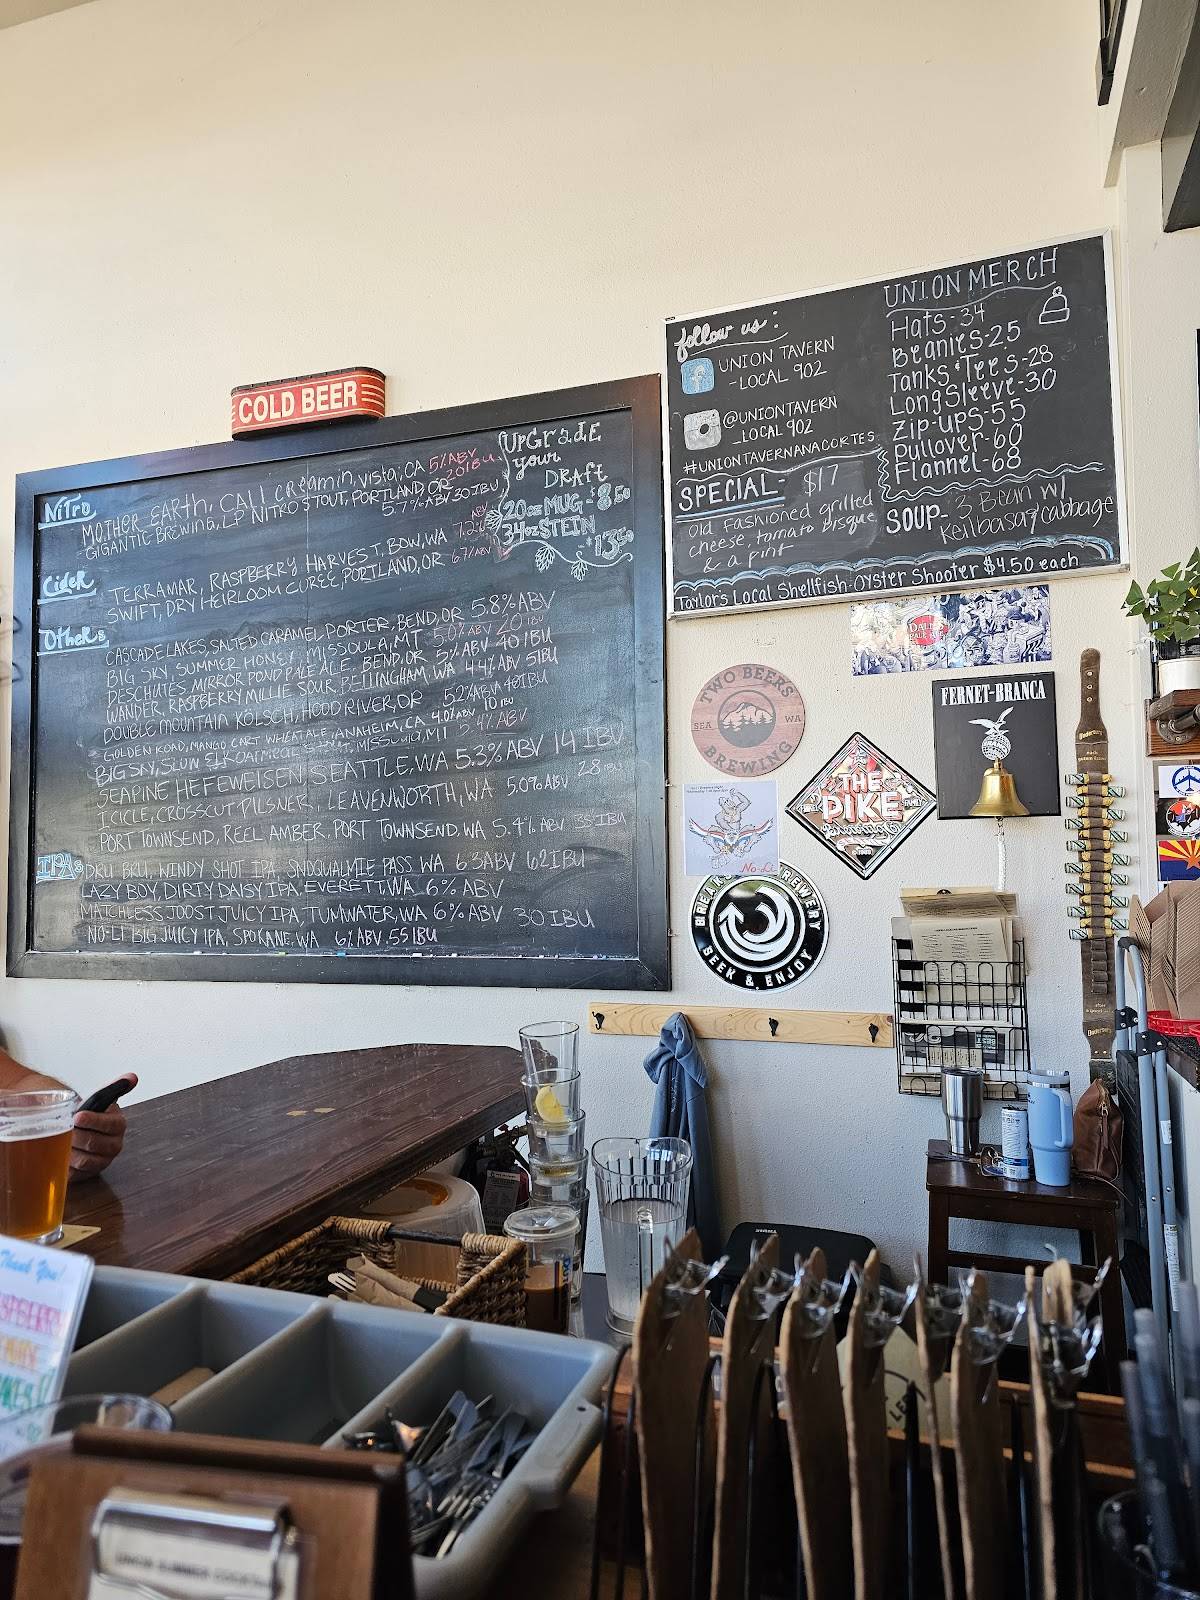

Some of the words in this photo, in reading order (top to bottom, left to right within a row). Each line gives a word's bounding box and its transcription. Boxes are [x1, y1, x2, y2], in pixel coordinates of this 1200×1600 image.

[883, 269, 962, 308] UNION
[968, 247, 1059, 291] MERCH
[674, 322, 734, 362] follow
[719, 349, 773, 373] UNION
[779, 336, 835, 360] TAVERN
[794, 360, 827, 380] 902
[888, 365, 950, 393] Tanks
[238, 391, 295, 424] COLD
[301, 380, 357, 414] BEER
[723, 395, 838, 429] @UNIONTAVERN
[786, 418, 814, 437] 902
[683, 431, 876, 475] #UNIONTAVERNANACORTES
[804, 464, 840, 497] $17
[543, 493, 583, 516] MUG
[819, 489, 874, 519] grilled
[978, 485, 1032, 513] Bean
[85, 531, 150, 560] GIGANTIC
[428, 477, 454, 496] OR
[539, 514, 596, 539] STEIN
[166, 599, 195, 618] DRY
[421, 551, 446, 569] OR
[733, 584, 773, 606] Local
[911, 562, 979, 585] Shooter
[984, 555, 1034, 576] $4.50
[1039, 552, 1080, 571] each
[105, 643, 166, 666] CASCADE
[209, 634, 257, 655] SALTED
[261, 626, 324, 646] CARAMEL
[441, 606, 465, 622] OR
[518, 590, 556, 613] ABV
[107, 668, 135, 688] BIG
[176, 656, 240, 677] SUMMER
[108, 680, 186, 708] DESCHUTES
[191, 671, 245, 693] MIRROR
[248, 668, 283, 685] POND
[286, 663, 318, 682] PALE
[405, 649, 428, 665] OR
[462, 637, 489, 657] ABV
[524, 627, 553, 648] IBU
[169, 688, 242, 713] RASPBERRY
[699, 670, 737, 705] TWO
[742, 664, 795, 699] BEERS
[940, 679, 1047, 706] FERNET-BRANCA
[103, 719, 157, 745] DOUBLE
[302, 701, 342, 721] HOOD
[396, 690, 423, 709] OR
[405, 715, 426, 730] CA
[785, 714, 802, 724] WA
[97, 781, 170, 808] SEAPINE
[415, 751, 450, 772] WA
[507, 734, 544, 760] ABV
[554, 729, 577, 755] 14
[704, 739, 794, 774] BREWING
[157, 802, 235, 823] CROSSCUT
[465, 777, 494, 801] WA
[577, 759, 602, 777] 28
[838, 771, 883, 792] THE
[822, 791, 903, 823] PIKE
[100, 830, 135, 853] PORT
[223, 824, 263, 845] REEL
[333, 818, 372, 841] PORT
[463, 820, 487, 840] WA
[159, 858, 205, 879] WINDY
[212, 860, 244, 879] SHOT
[382, 856, 413, 876] PASS
[420, 853, 445, 873] WA
[81, 883, 122, 900] LAZY
[163, 881, 213, 900] DIRTY
[217, 881, 263, 901] DAISY
[462, 878, 504, 899] ABV
[80, 903, 164, 922] MATCHLESS
[166, 905, 216, 921] JOOST
[218, 905, 267, 923] JUICY
[399, 904, 428, 924] WA
[468, 905, 503, 922] ABV
[512, 907, 545, 926] 30
[548, 908, 595, 928] IBU
[131, 926, 157, 944] BIG
[161, 925, 198, 945] JUICY
[295, 931, 320, 948] WA
[413, 927, 438, 946] IBU
[745, 974, 755, 987] &
[765, 948, 813, 988] ENJOY
